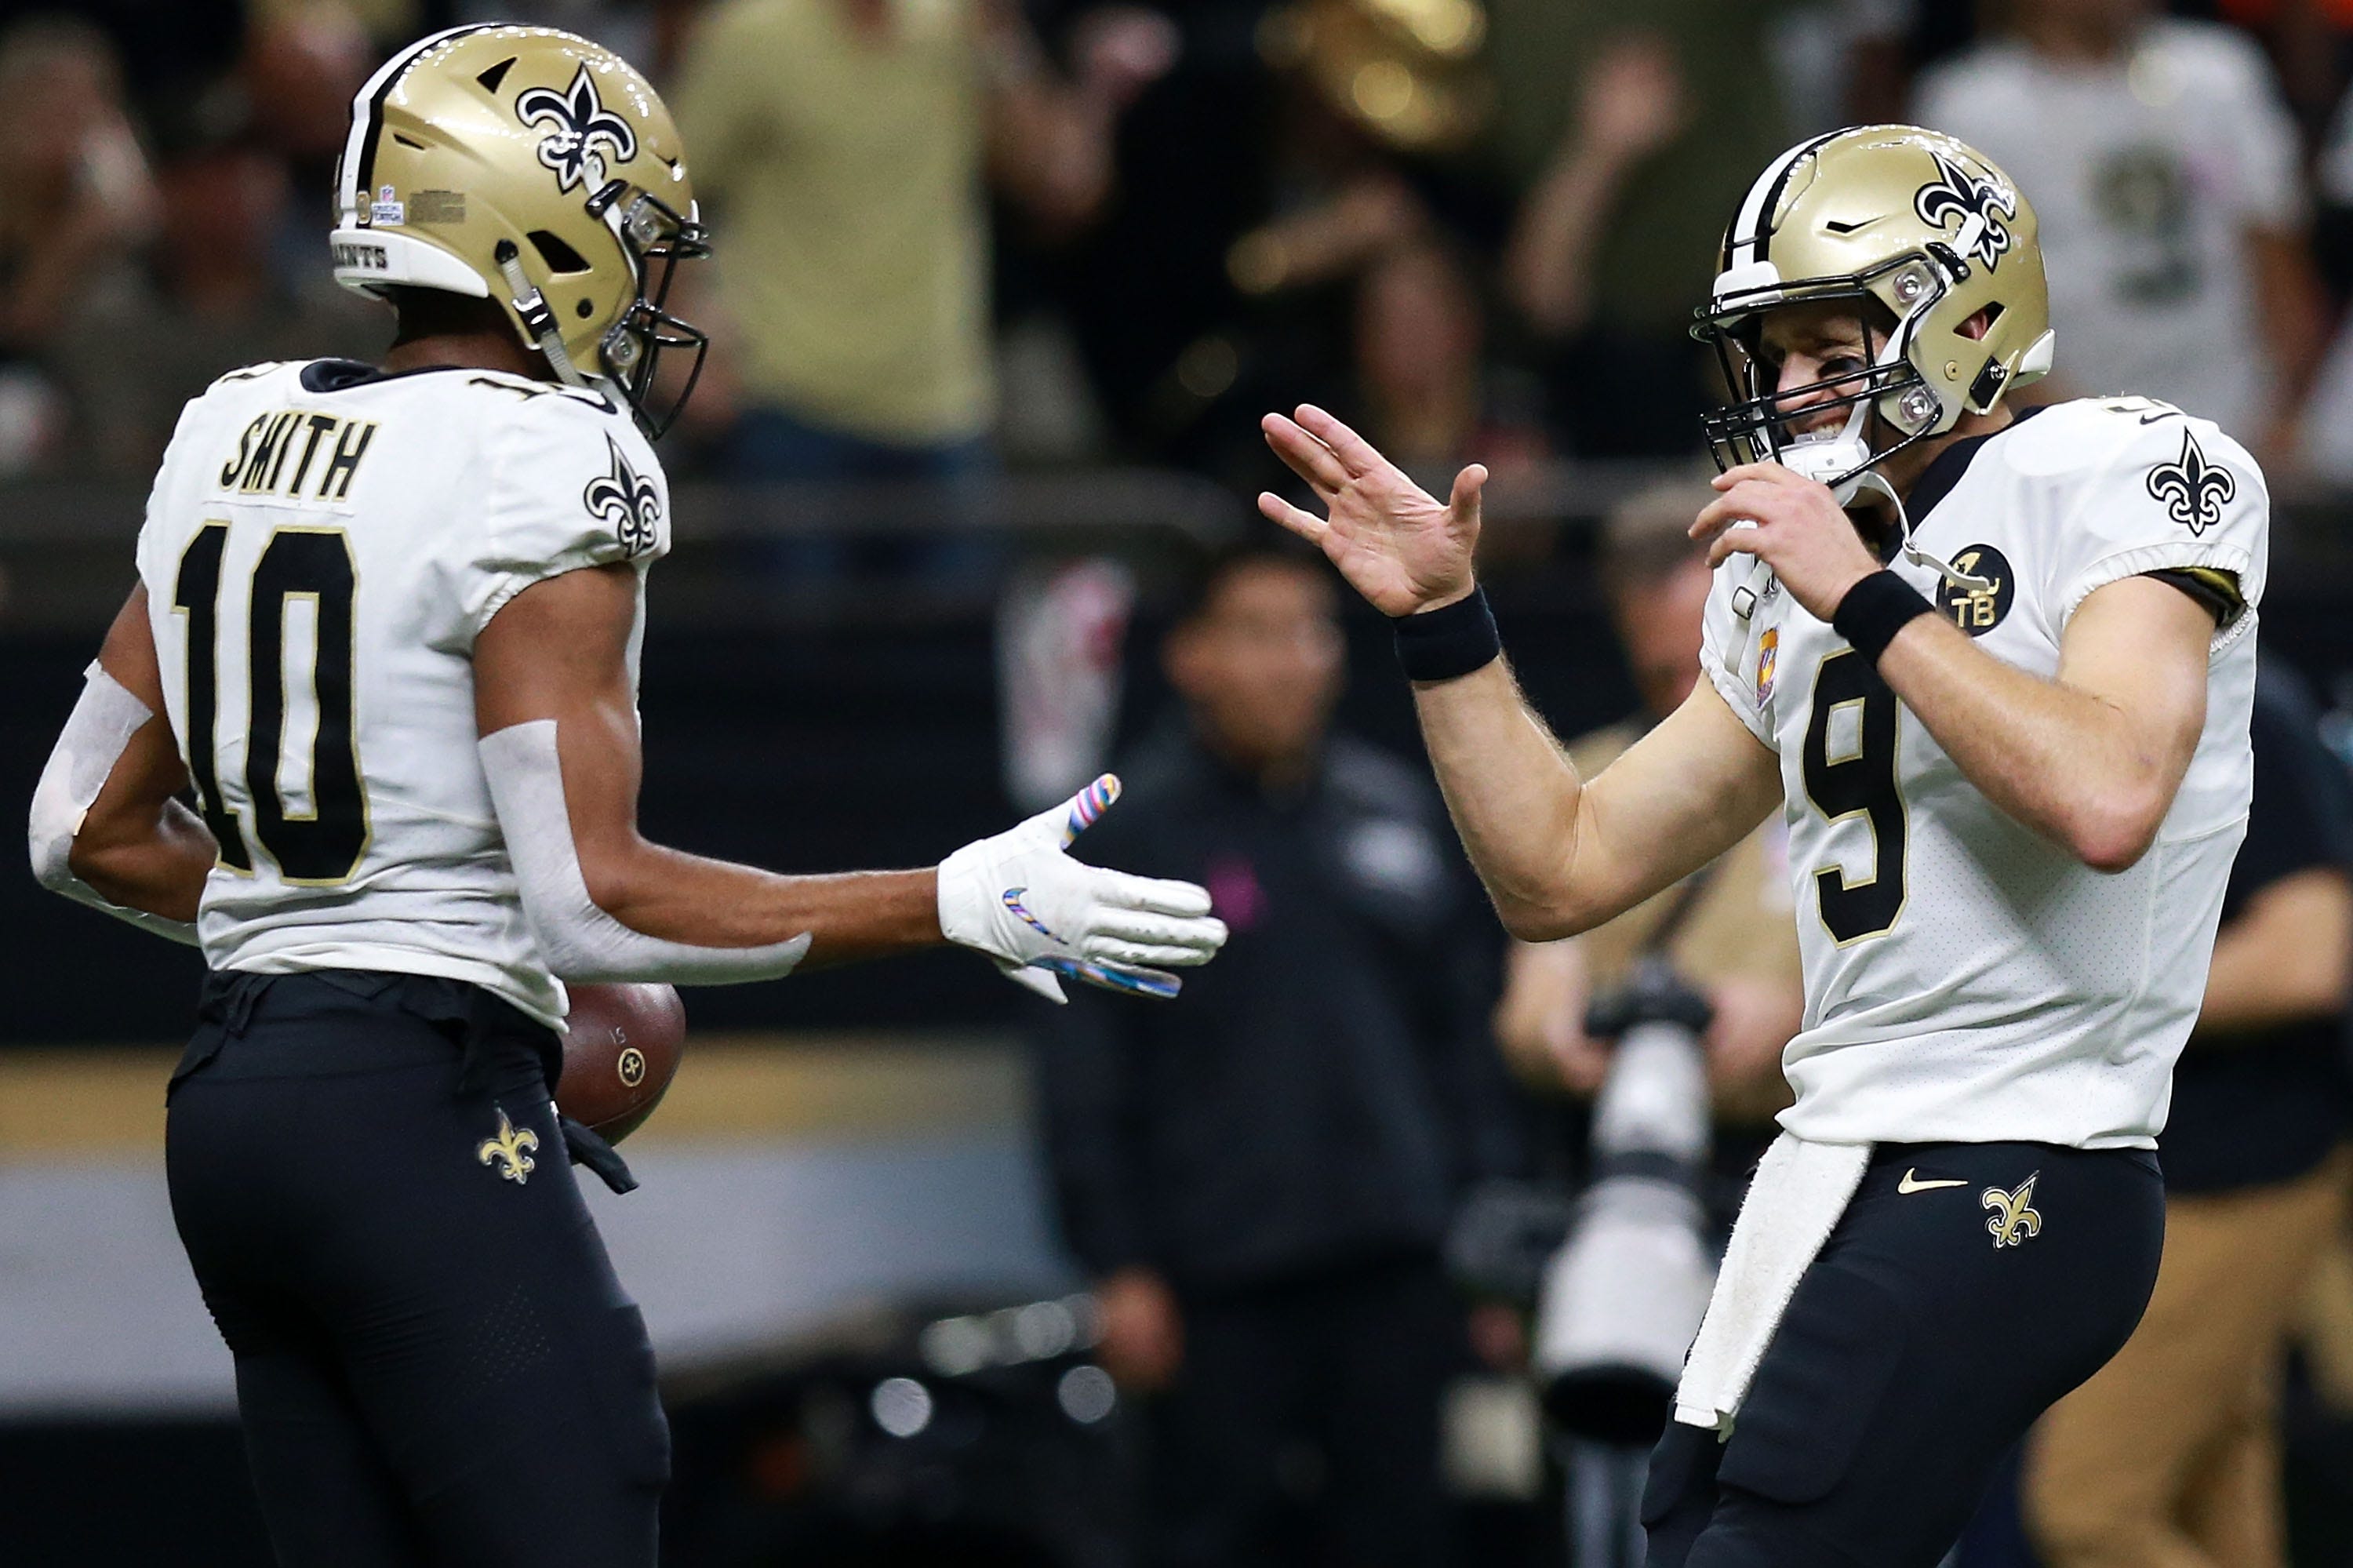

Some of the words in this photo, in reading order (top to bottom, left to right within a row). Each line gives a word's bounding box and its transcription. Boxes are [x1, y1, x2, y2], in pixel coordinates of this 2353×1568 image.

[218, 409, 381, 503] SMITH
[169, 518, 372, 887] 10
[1951, 597, 1996, 628] TB
[1801, 646, 1909, 950] 9
